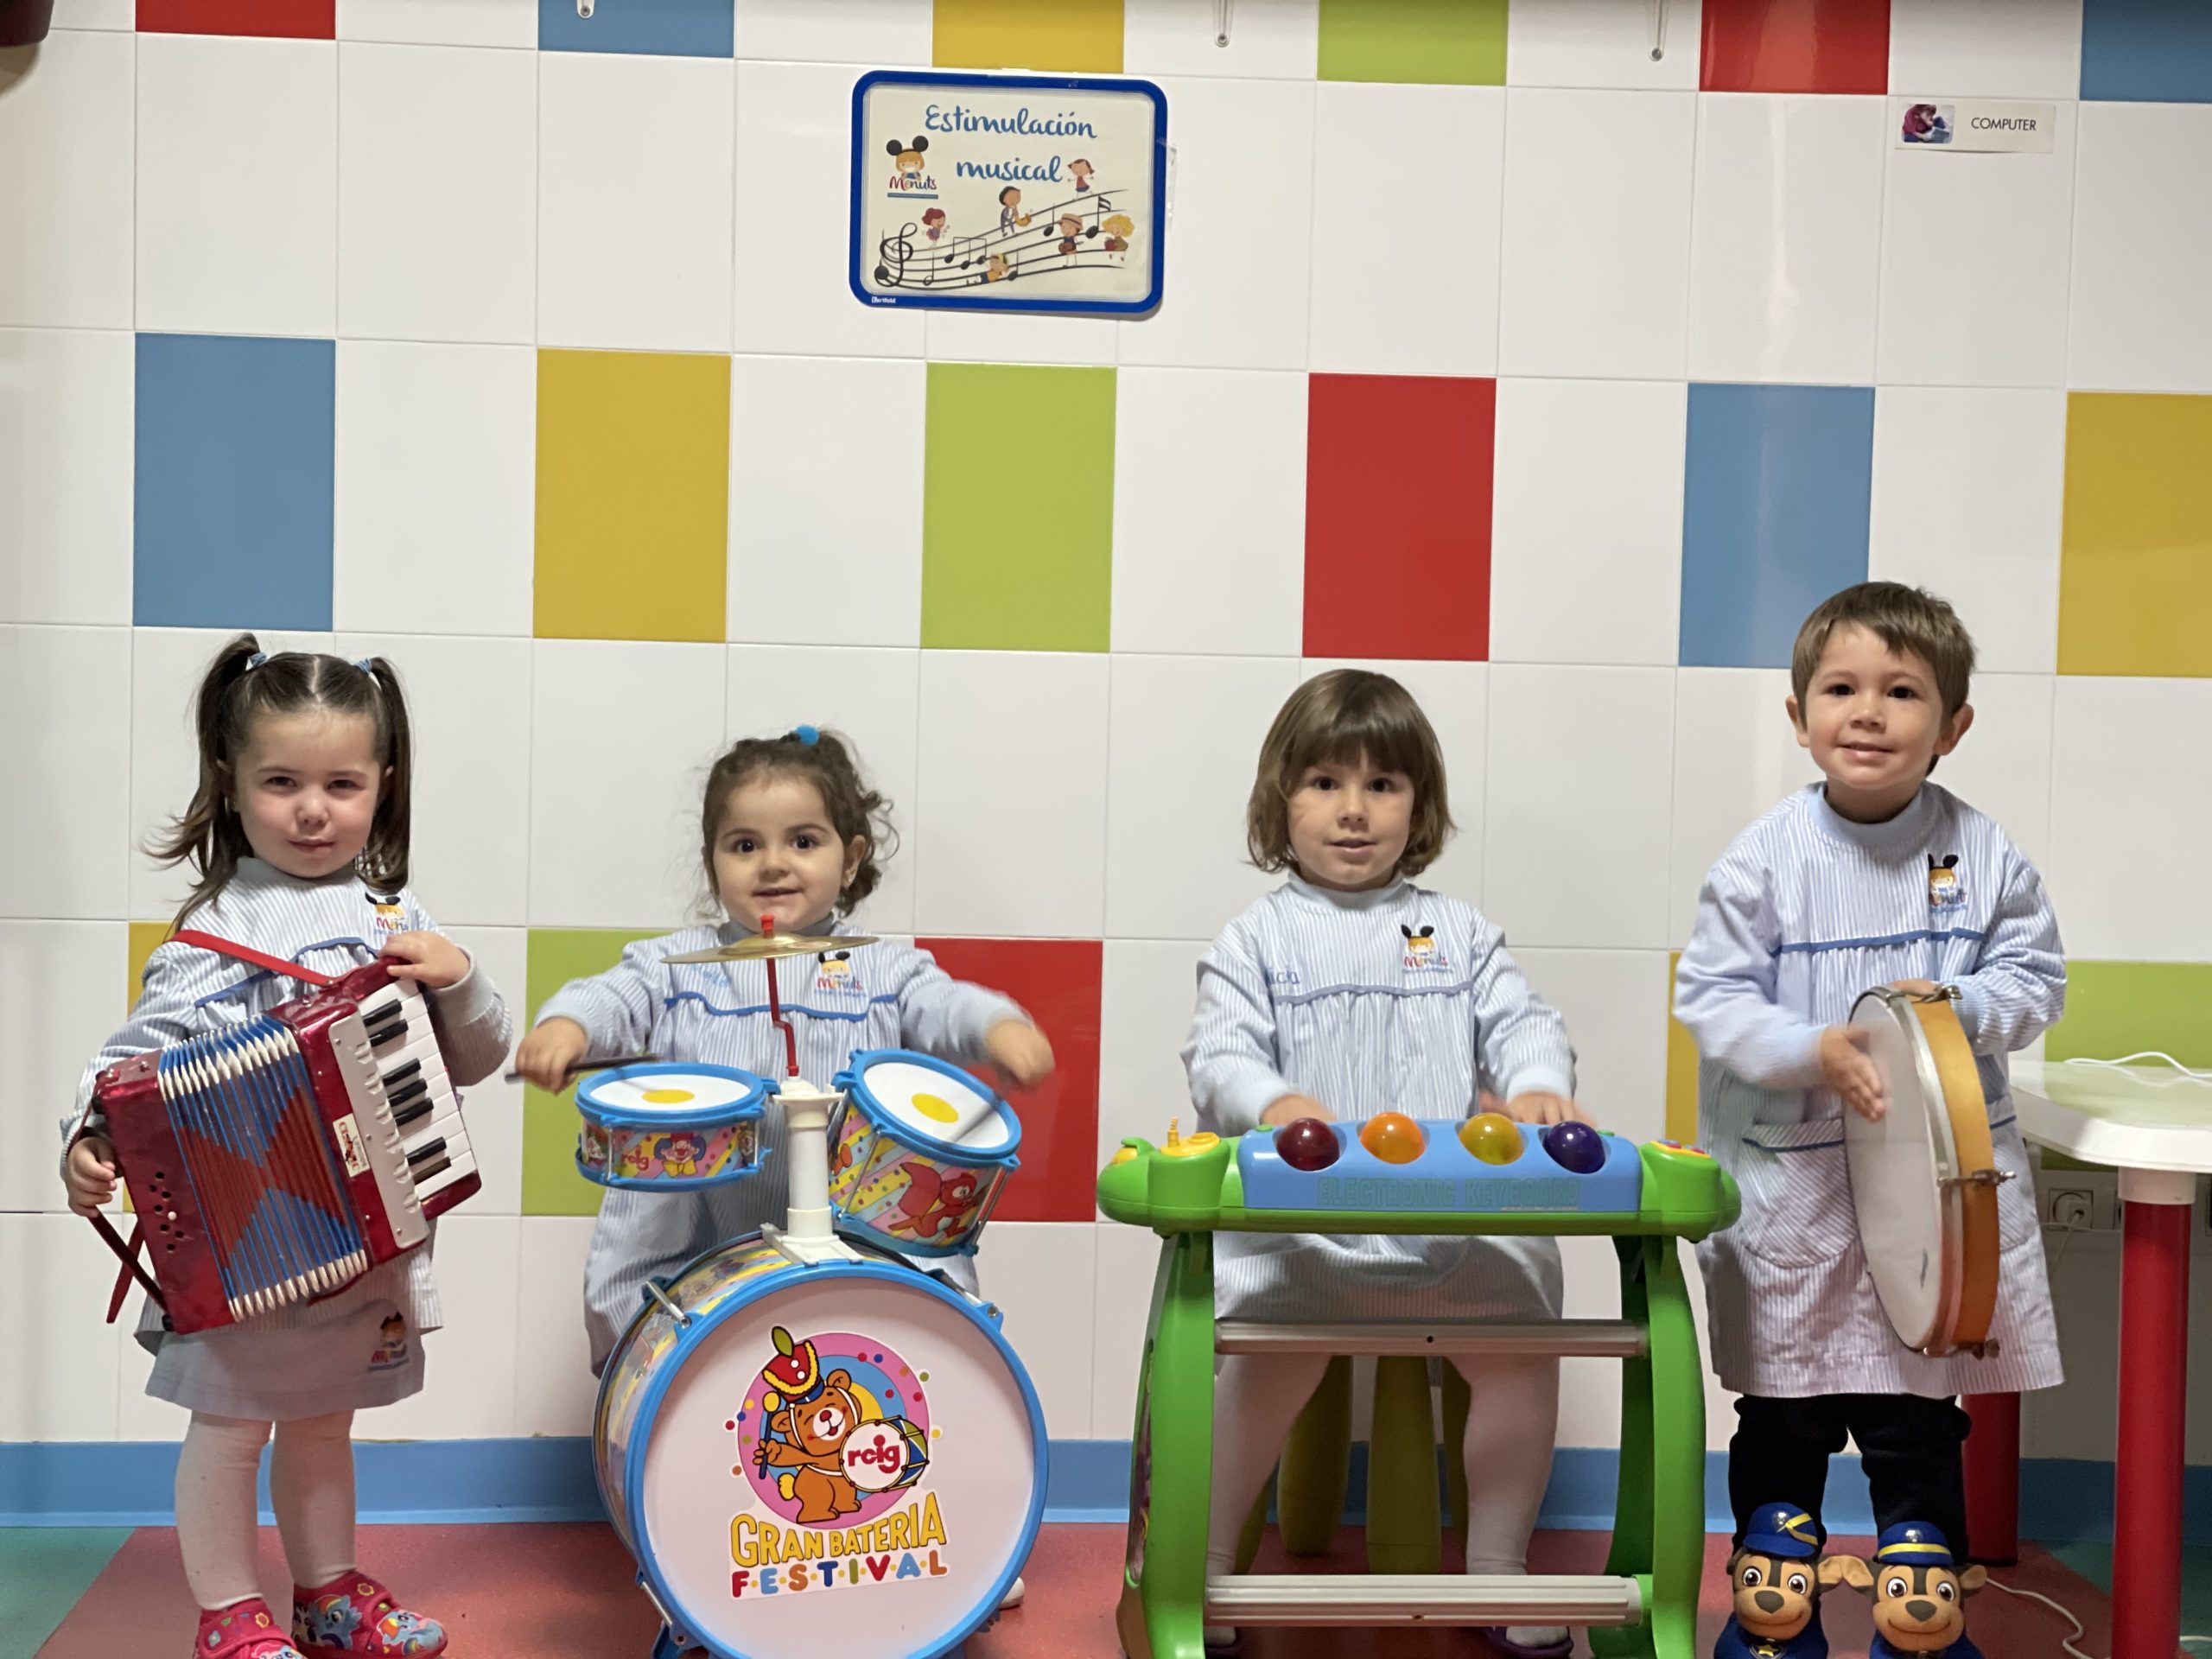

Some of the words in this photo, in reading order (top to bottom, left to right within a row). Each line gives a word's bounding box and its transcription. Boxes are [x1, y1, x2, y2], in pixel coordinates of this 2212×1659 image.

[925, 104, 1098, 139] Estimulación
[1971, 118, 2037, 131] COMPUTER
[956, 156, 1064, 183] musical
[1316, 1176, 1457, 1208] ELECTRONIC
[730, 1513, 824, 1568] GRAN
[829, 1491, 948, 1558] BATERIA
